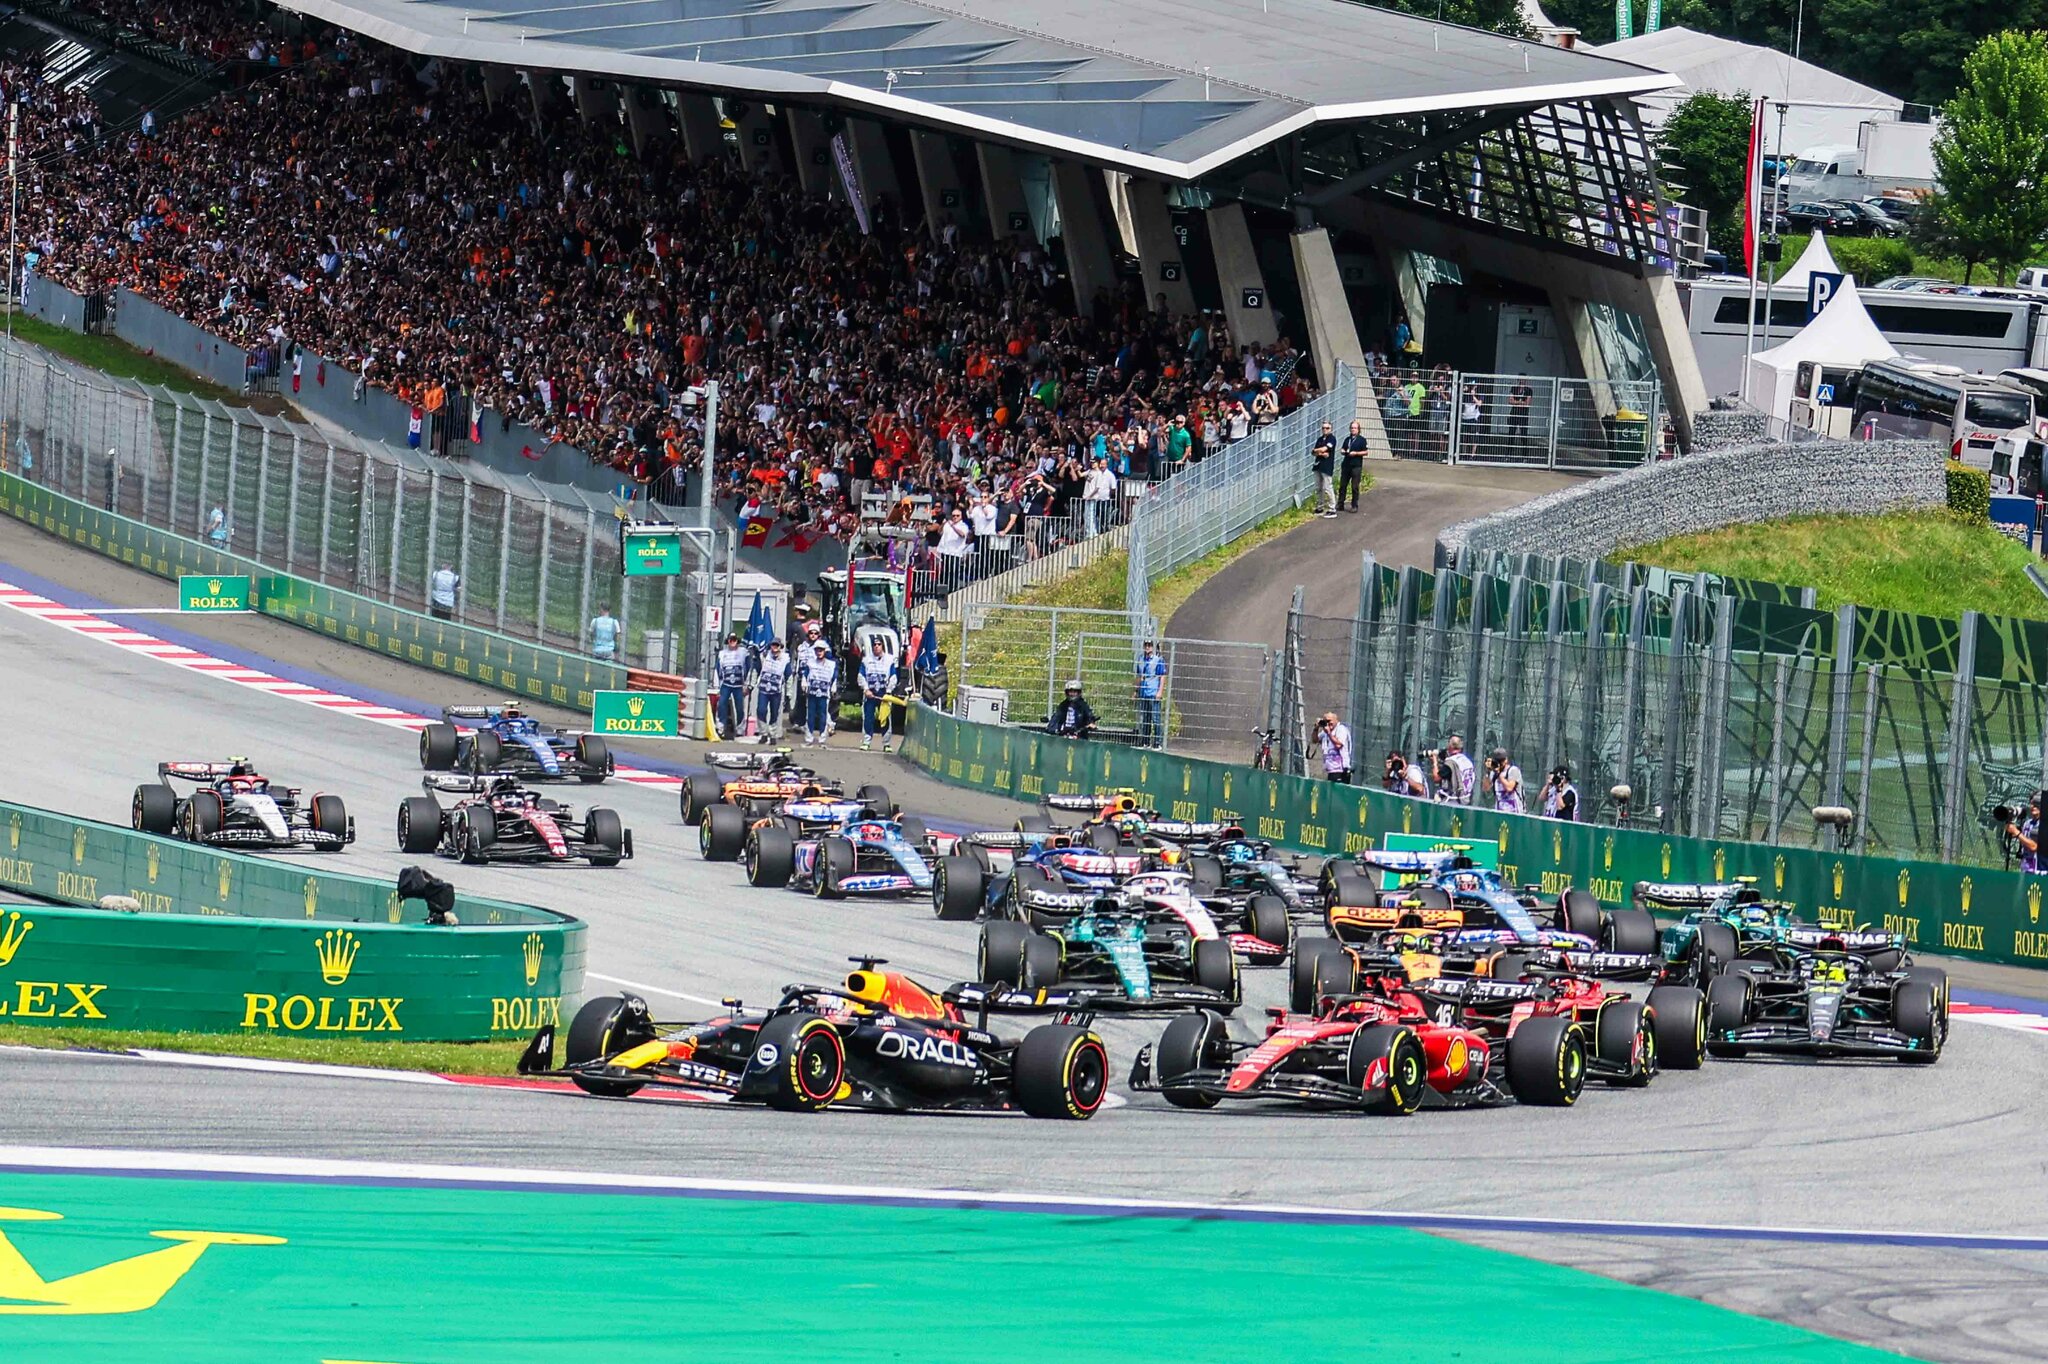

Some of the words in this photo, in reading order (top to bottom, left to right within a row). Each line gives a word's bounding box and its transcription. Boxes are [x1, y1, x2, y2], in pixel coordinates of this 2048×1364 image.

[1166, 269, 1176, 279] Q
[1247, 295, 1258, 306] Q
[1813, 276, 1831, 313] P
[638, 549, 668, 557] ROLEX
[189, 597, 239, 608] ROLEX
[991, 702, 999, 711] B
[605, 718, 665, 733] ROLEX
[1171, 800, 1198, 822] ROLEX
[1258, 816, 1286, 840] ROLEX
[1300, 823, 1328, 848] ROLEX
[57, 871, 98, 901] ROLEX
[1589, 877, 1623, 902] ROLEX
[1944, 922, 1984, 951] ROLEX
[2014, 930, 2048, 959] ROLE
[238, 993, 404, 1032] ROLEX
[490, 997, 562, 1031] ROLEX
[1435, 1003, 1452, 1028] 16
[876, 1031, 978, 1068] ORACLE
